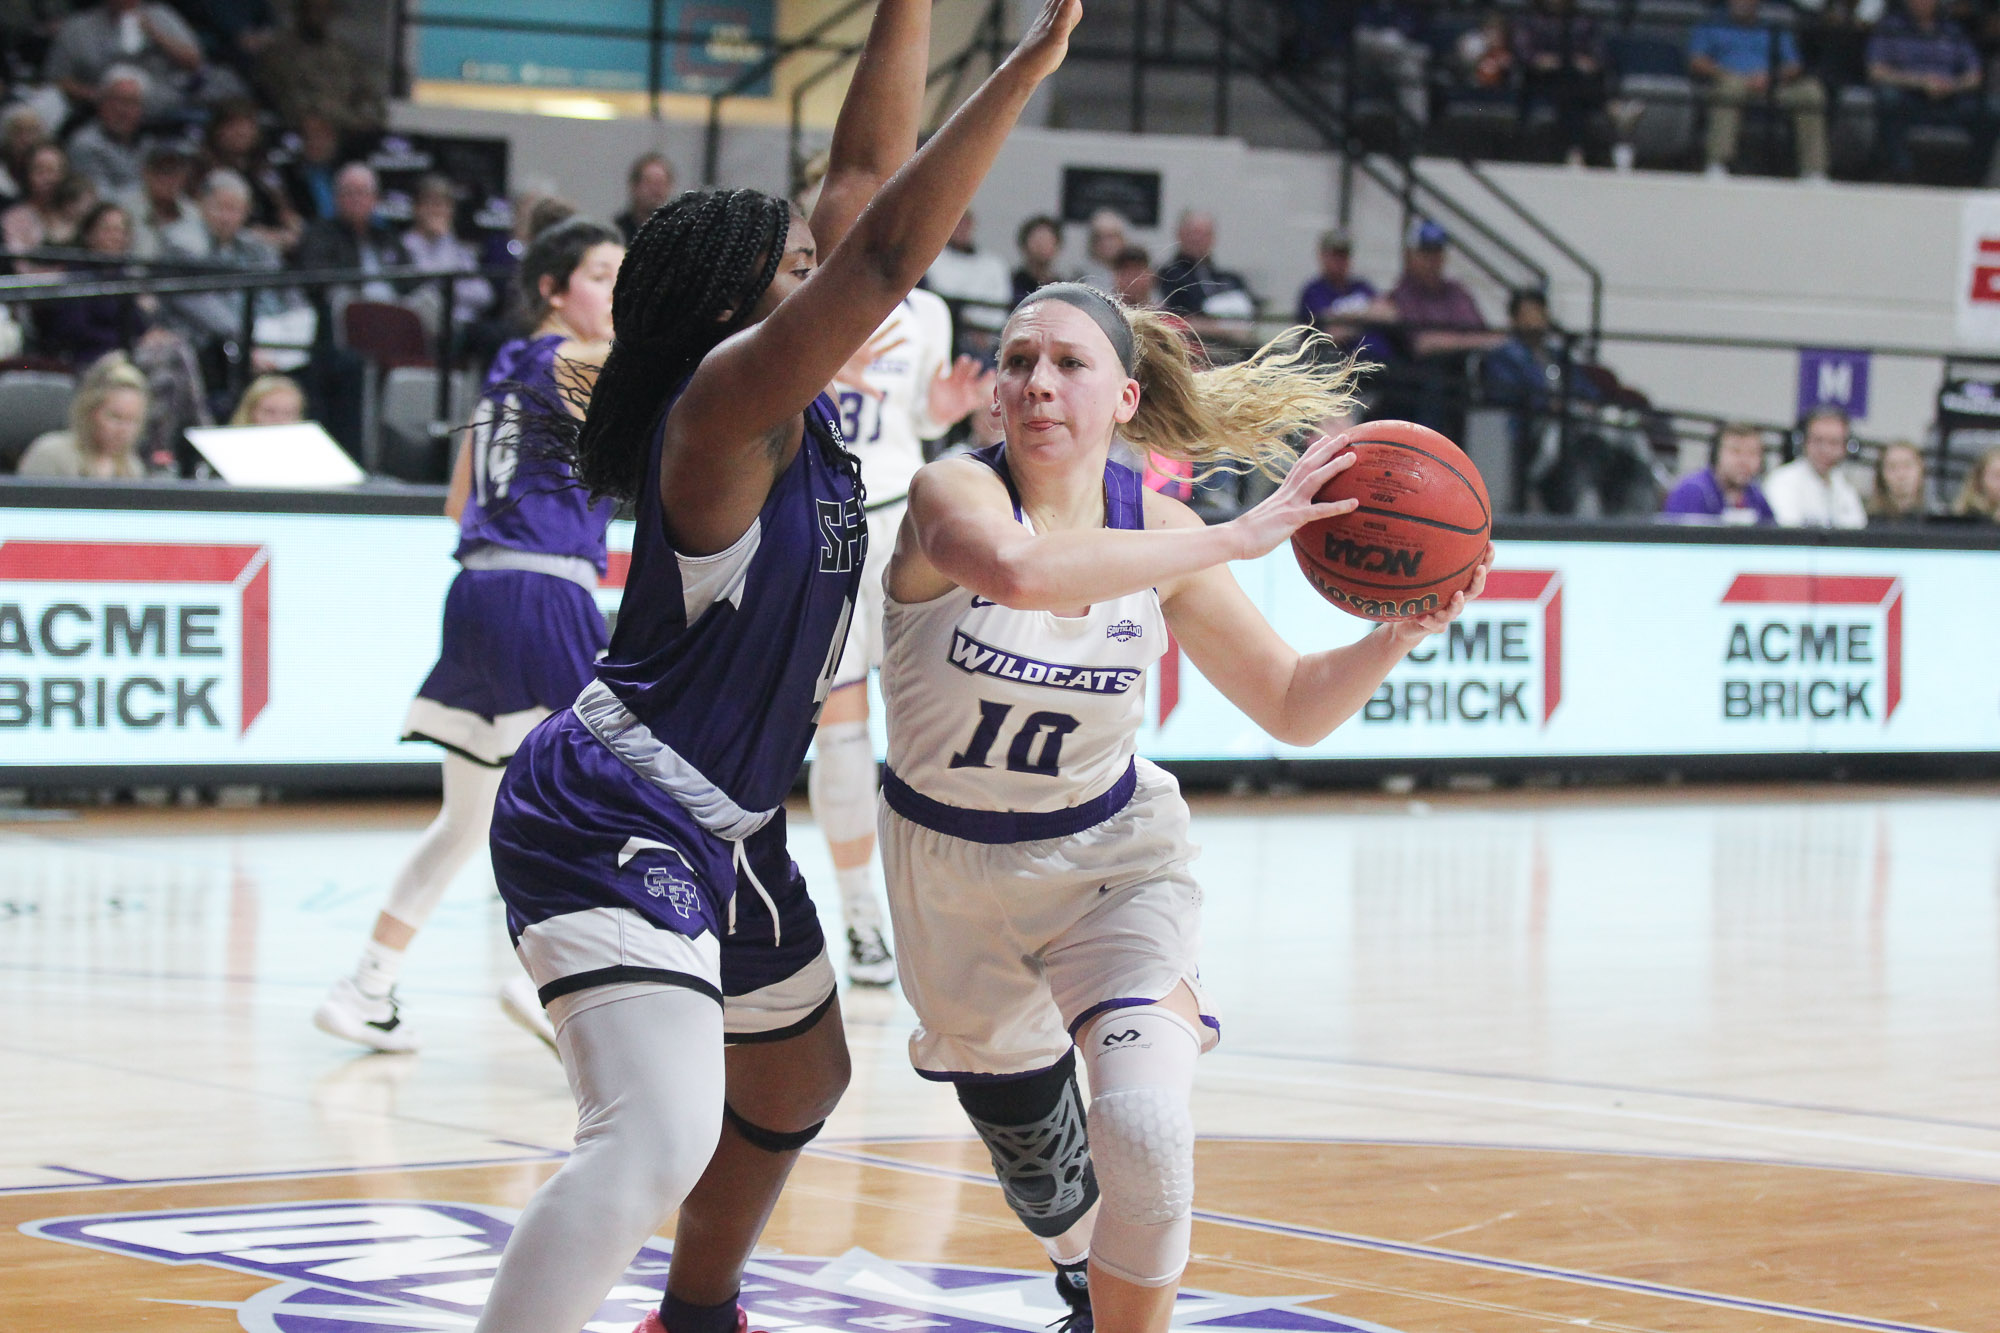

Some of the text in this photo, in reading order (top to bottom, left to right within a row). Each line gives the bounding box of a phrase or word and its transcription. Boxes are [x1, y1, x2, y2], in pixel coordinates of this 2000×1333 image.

[1325, 531, 1424, 577] NCAA
[1308, 567, 1439, 617] Wilson
[0, 603, 223, 657] ACME
[1727, 623, 1873, 663] ACME
[951, 634, 1140, 692] WILDCATS
[0, 677, 222, 728] BRICK
[1363, 681, 1528, 721] BRICK
[1725, 681, 1872, 718] BRICK
[947, 698, 1082, 777] 10
